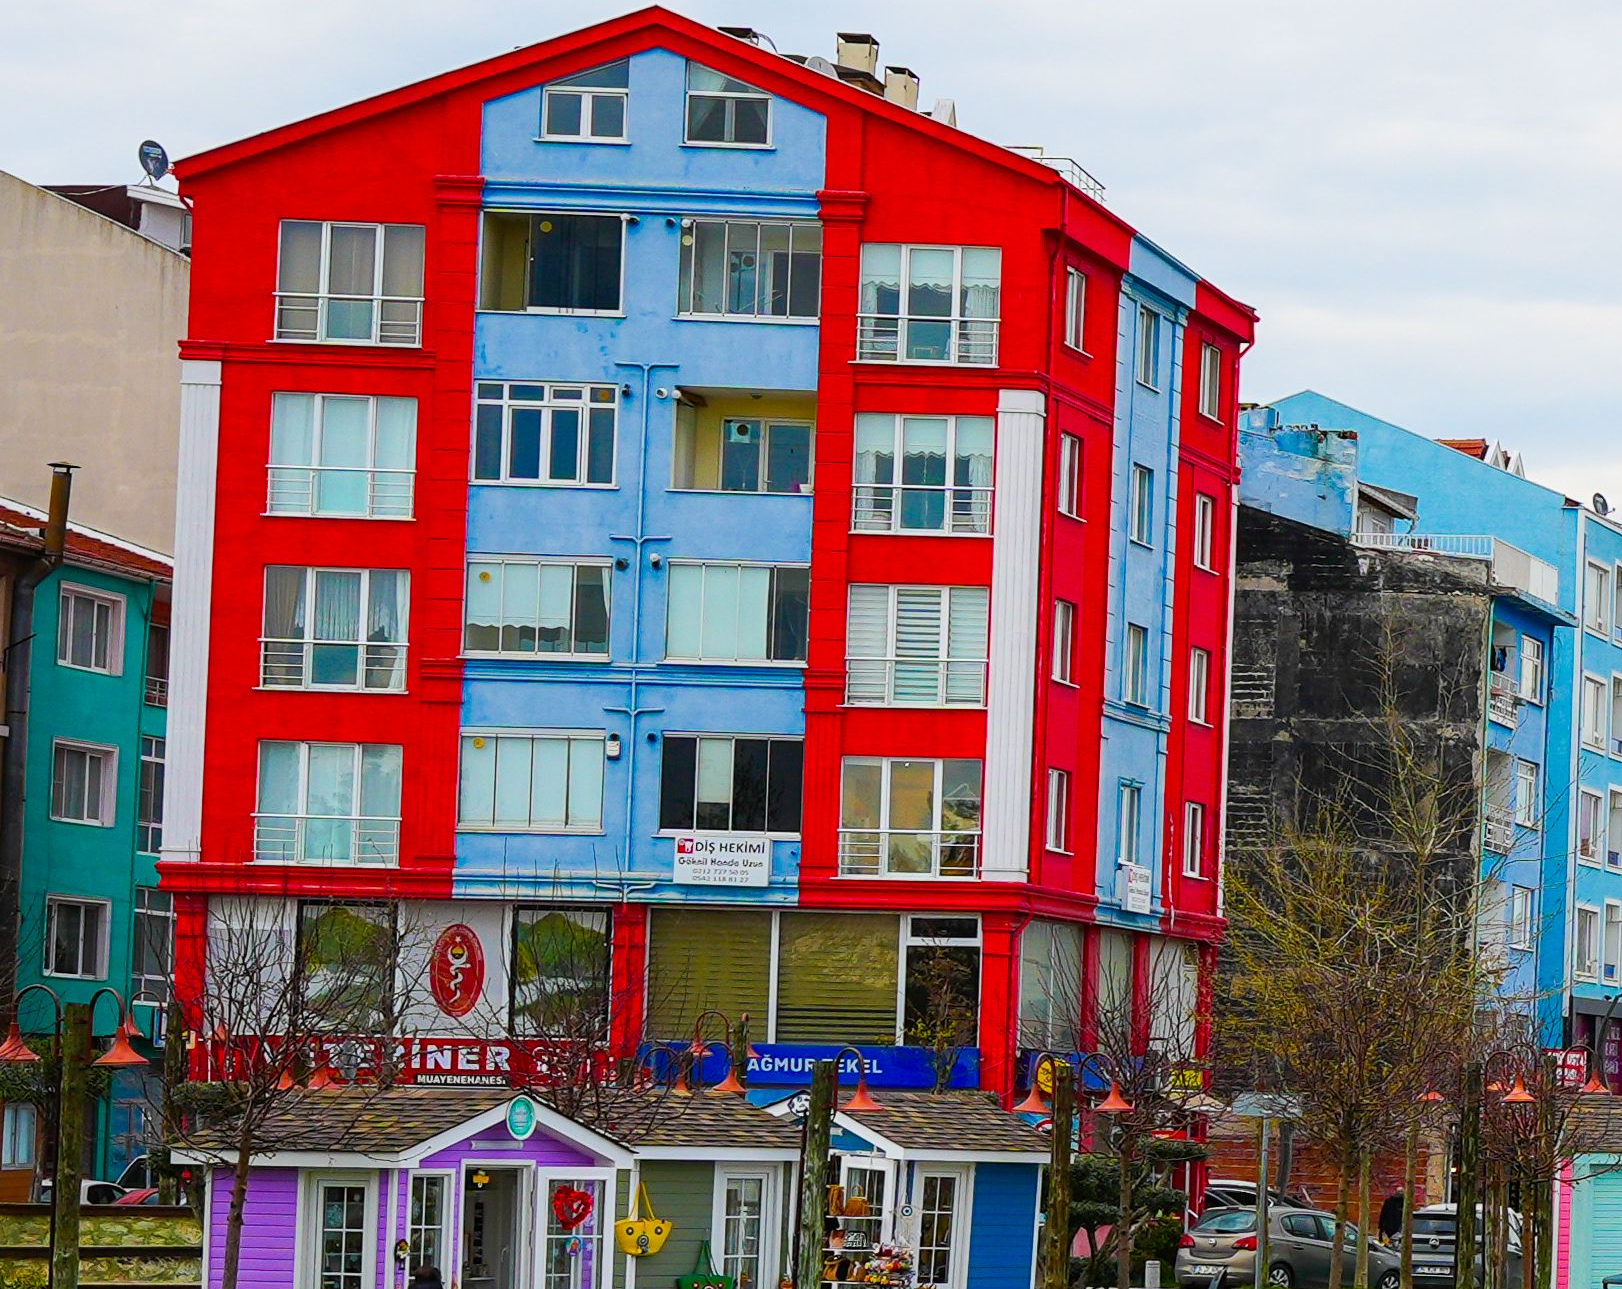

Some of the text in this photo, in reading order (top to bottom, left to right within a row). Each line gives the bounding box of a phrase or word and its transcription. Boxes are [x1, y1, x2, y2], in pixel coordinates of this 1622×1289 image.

[719, 840, 766, 854] HEKİMİ
[746, 1054, 883, 1074] AĞMUR EKEL
